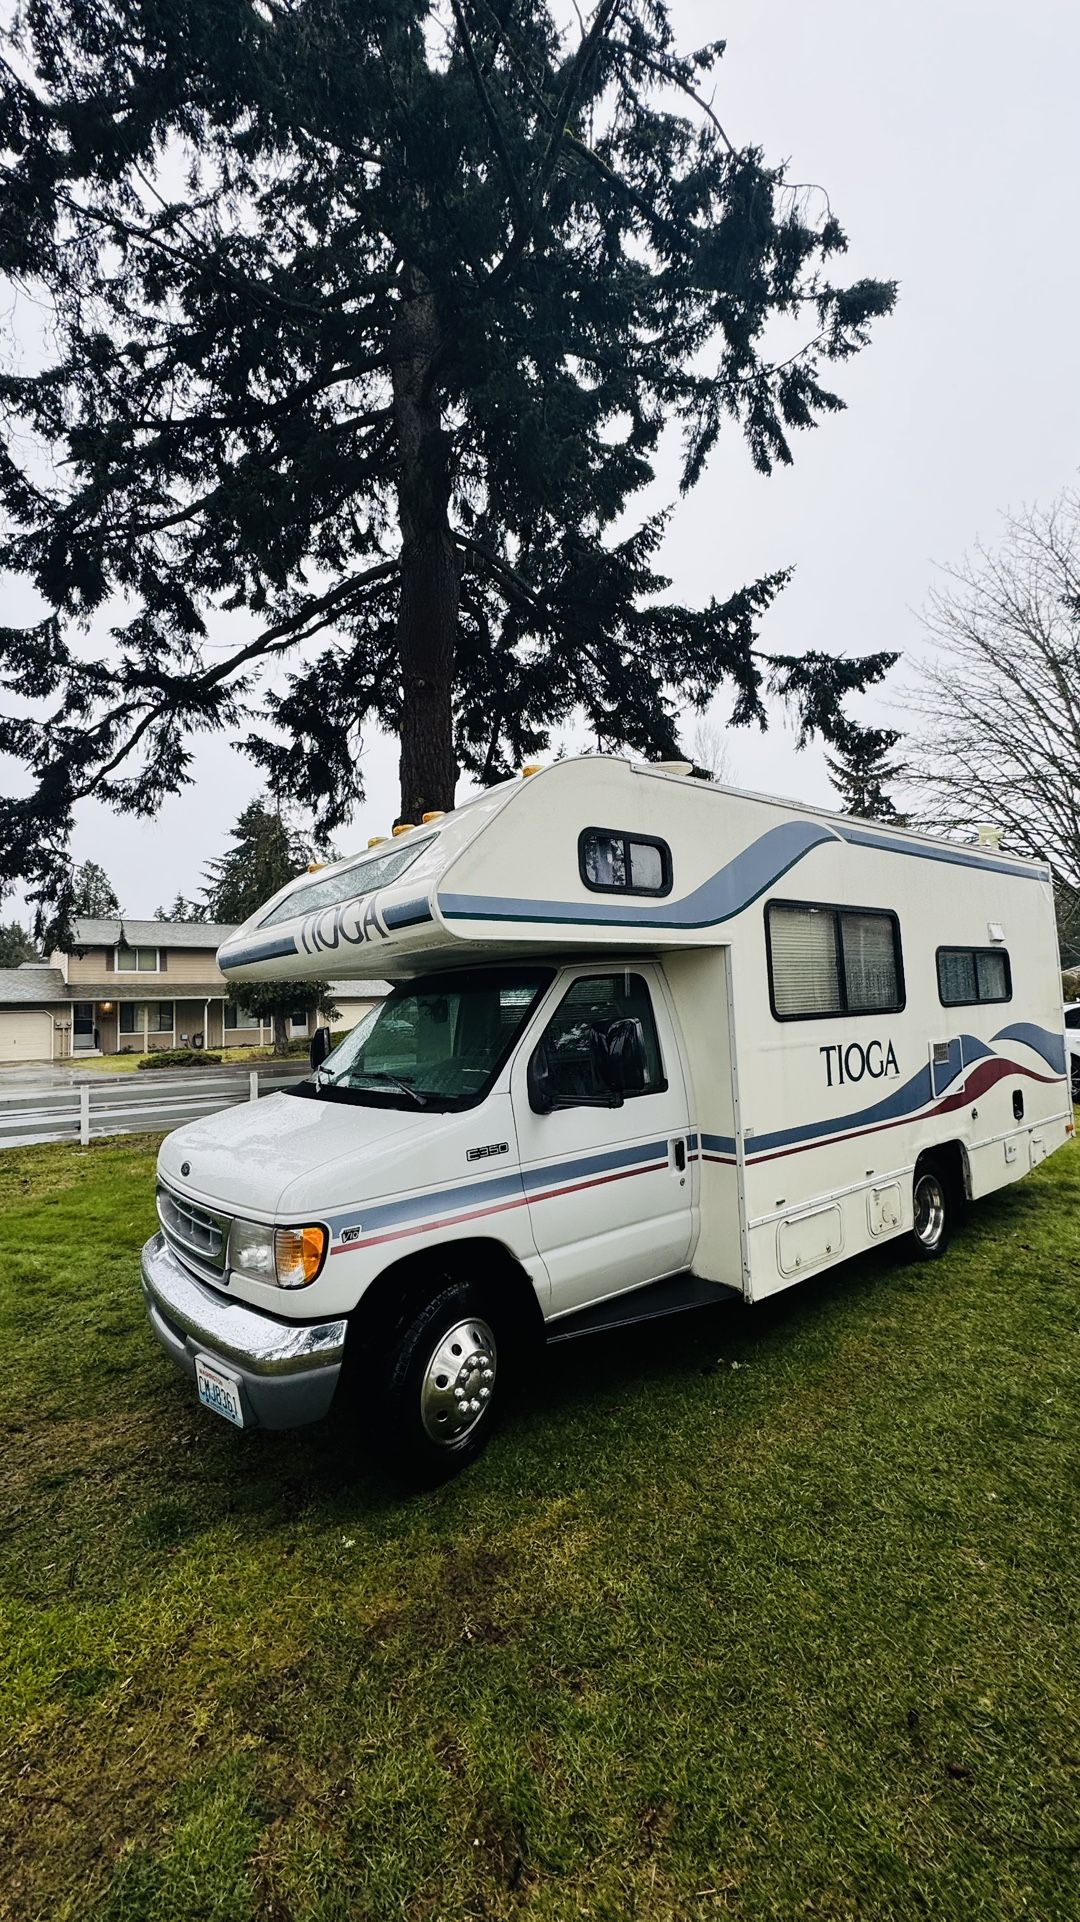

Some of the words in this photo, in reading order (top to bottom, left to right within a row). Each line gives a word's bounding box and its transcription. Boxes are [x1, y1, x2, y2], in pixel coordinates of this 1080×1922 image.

[301, 892, 390, 955] TIOGA
[819, 1038, 900, 1087] TIOGA
[466, 1142, 510, 1162] E350
[342, 1231, 359, 1243] V10
